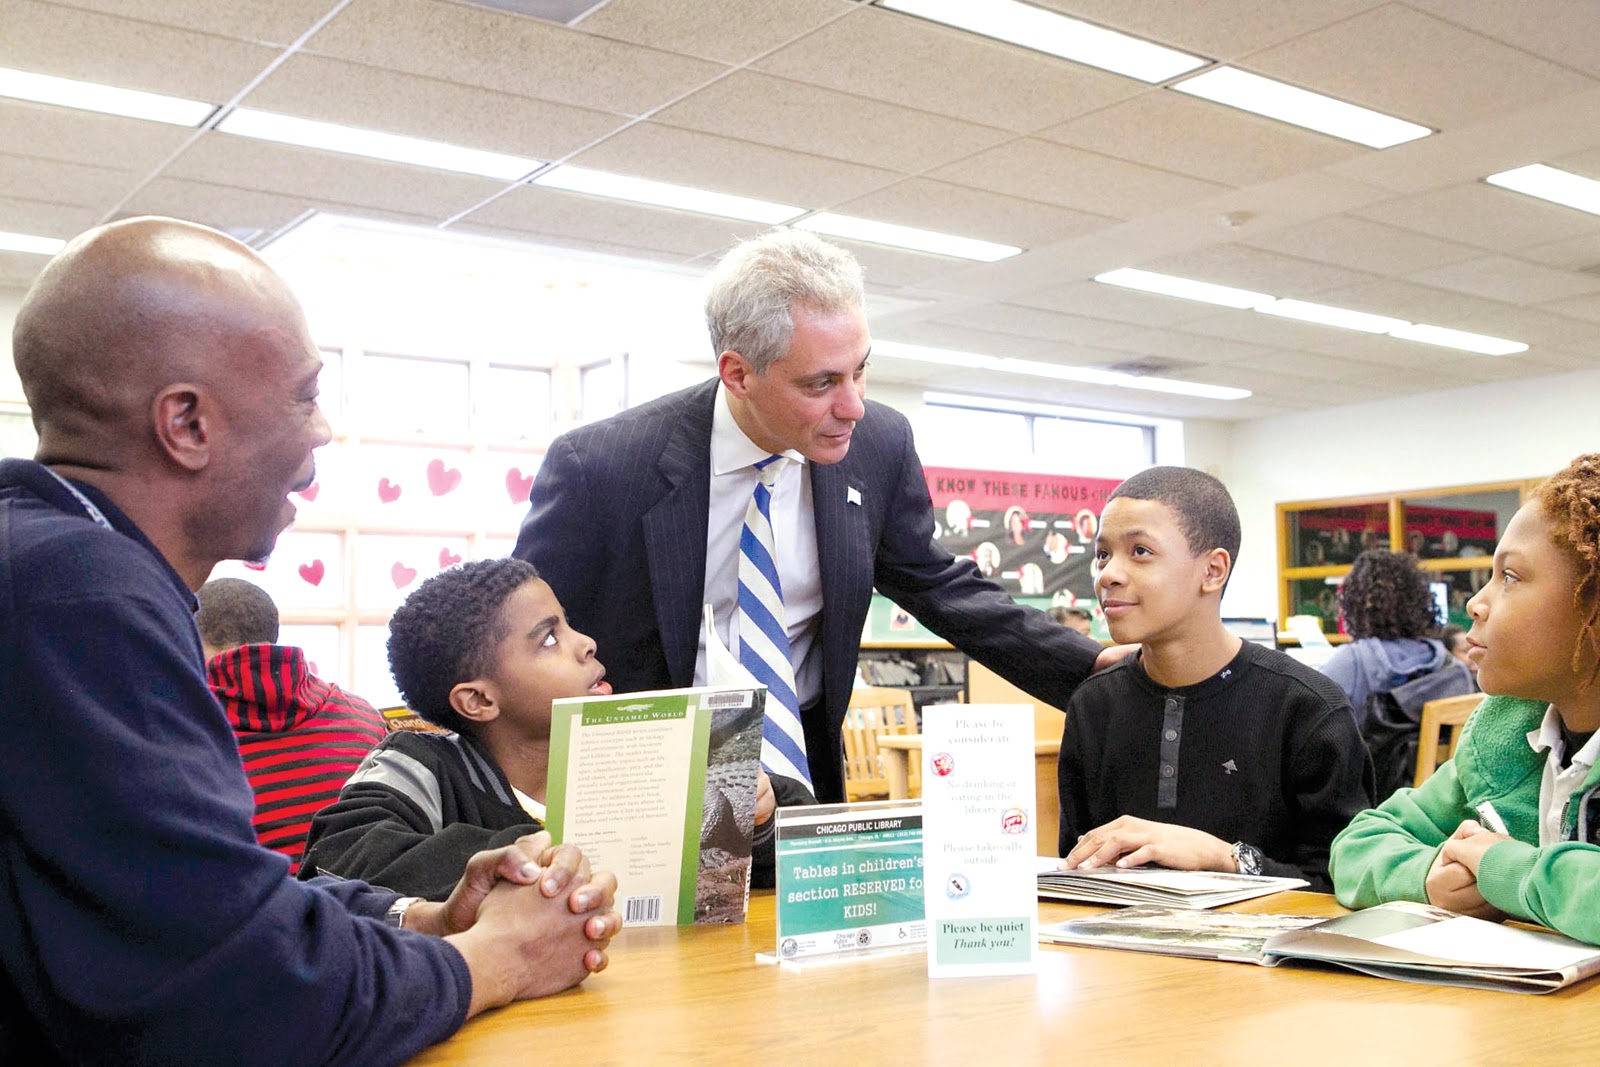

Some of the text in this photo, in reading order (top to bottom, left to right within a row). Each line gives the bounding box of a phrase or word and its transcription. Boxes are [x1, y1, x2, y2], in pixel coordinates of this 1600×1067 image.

[937, 479, 976, 493] KNOW
[983, 481, 1028, 497] THESE
[1034, 484, 1088, 500] FAMOUS
[606, 714, 649, 722] UNTAMED
[651, 711, 684, 719] WORLD
[955, 719, 1005, 729] Please be
[949, 734, 1011, 744] considerate
[947, 780, 960, 788] No
[962, 779, 1005, 789] drinking
[951, 794, 981, 802] eating
[816, 820, 902, 835] CHICAGO PUBLIC LIBRARY
[943, 841, 1022, 852] Please take calls
[964, 854, 998, 864] outside
[793, 856, 924, 879] Tables in children's
[787, 886, 839, 903] section
[843, 878, 906, 897] RESERVED
[843, 903, 877, 918] KIDS!
[943, 922, 1025, 935] Please be quiet
[953, 937, 1015, 950] Thank you!
